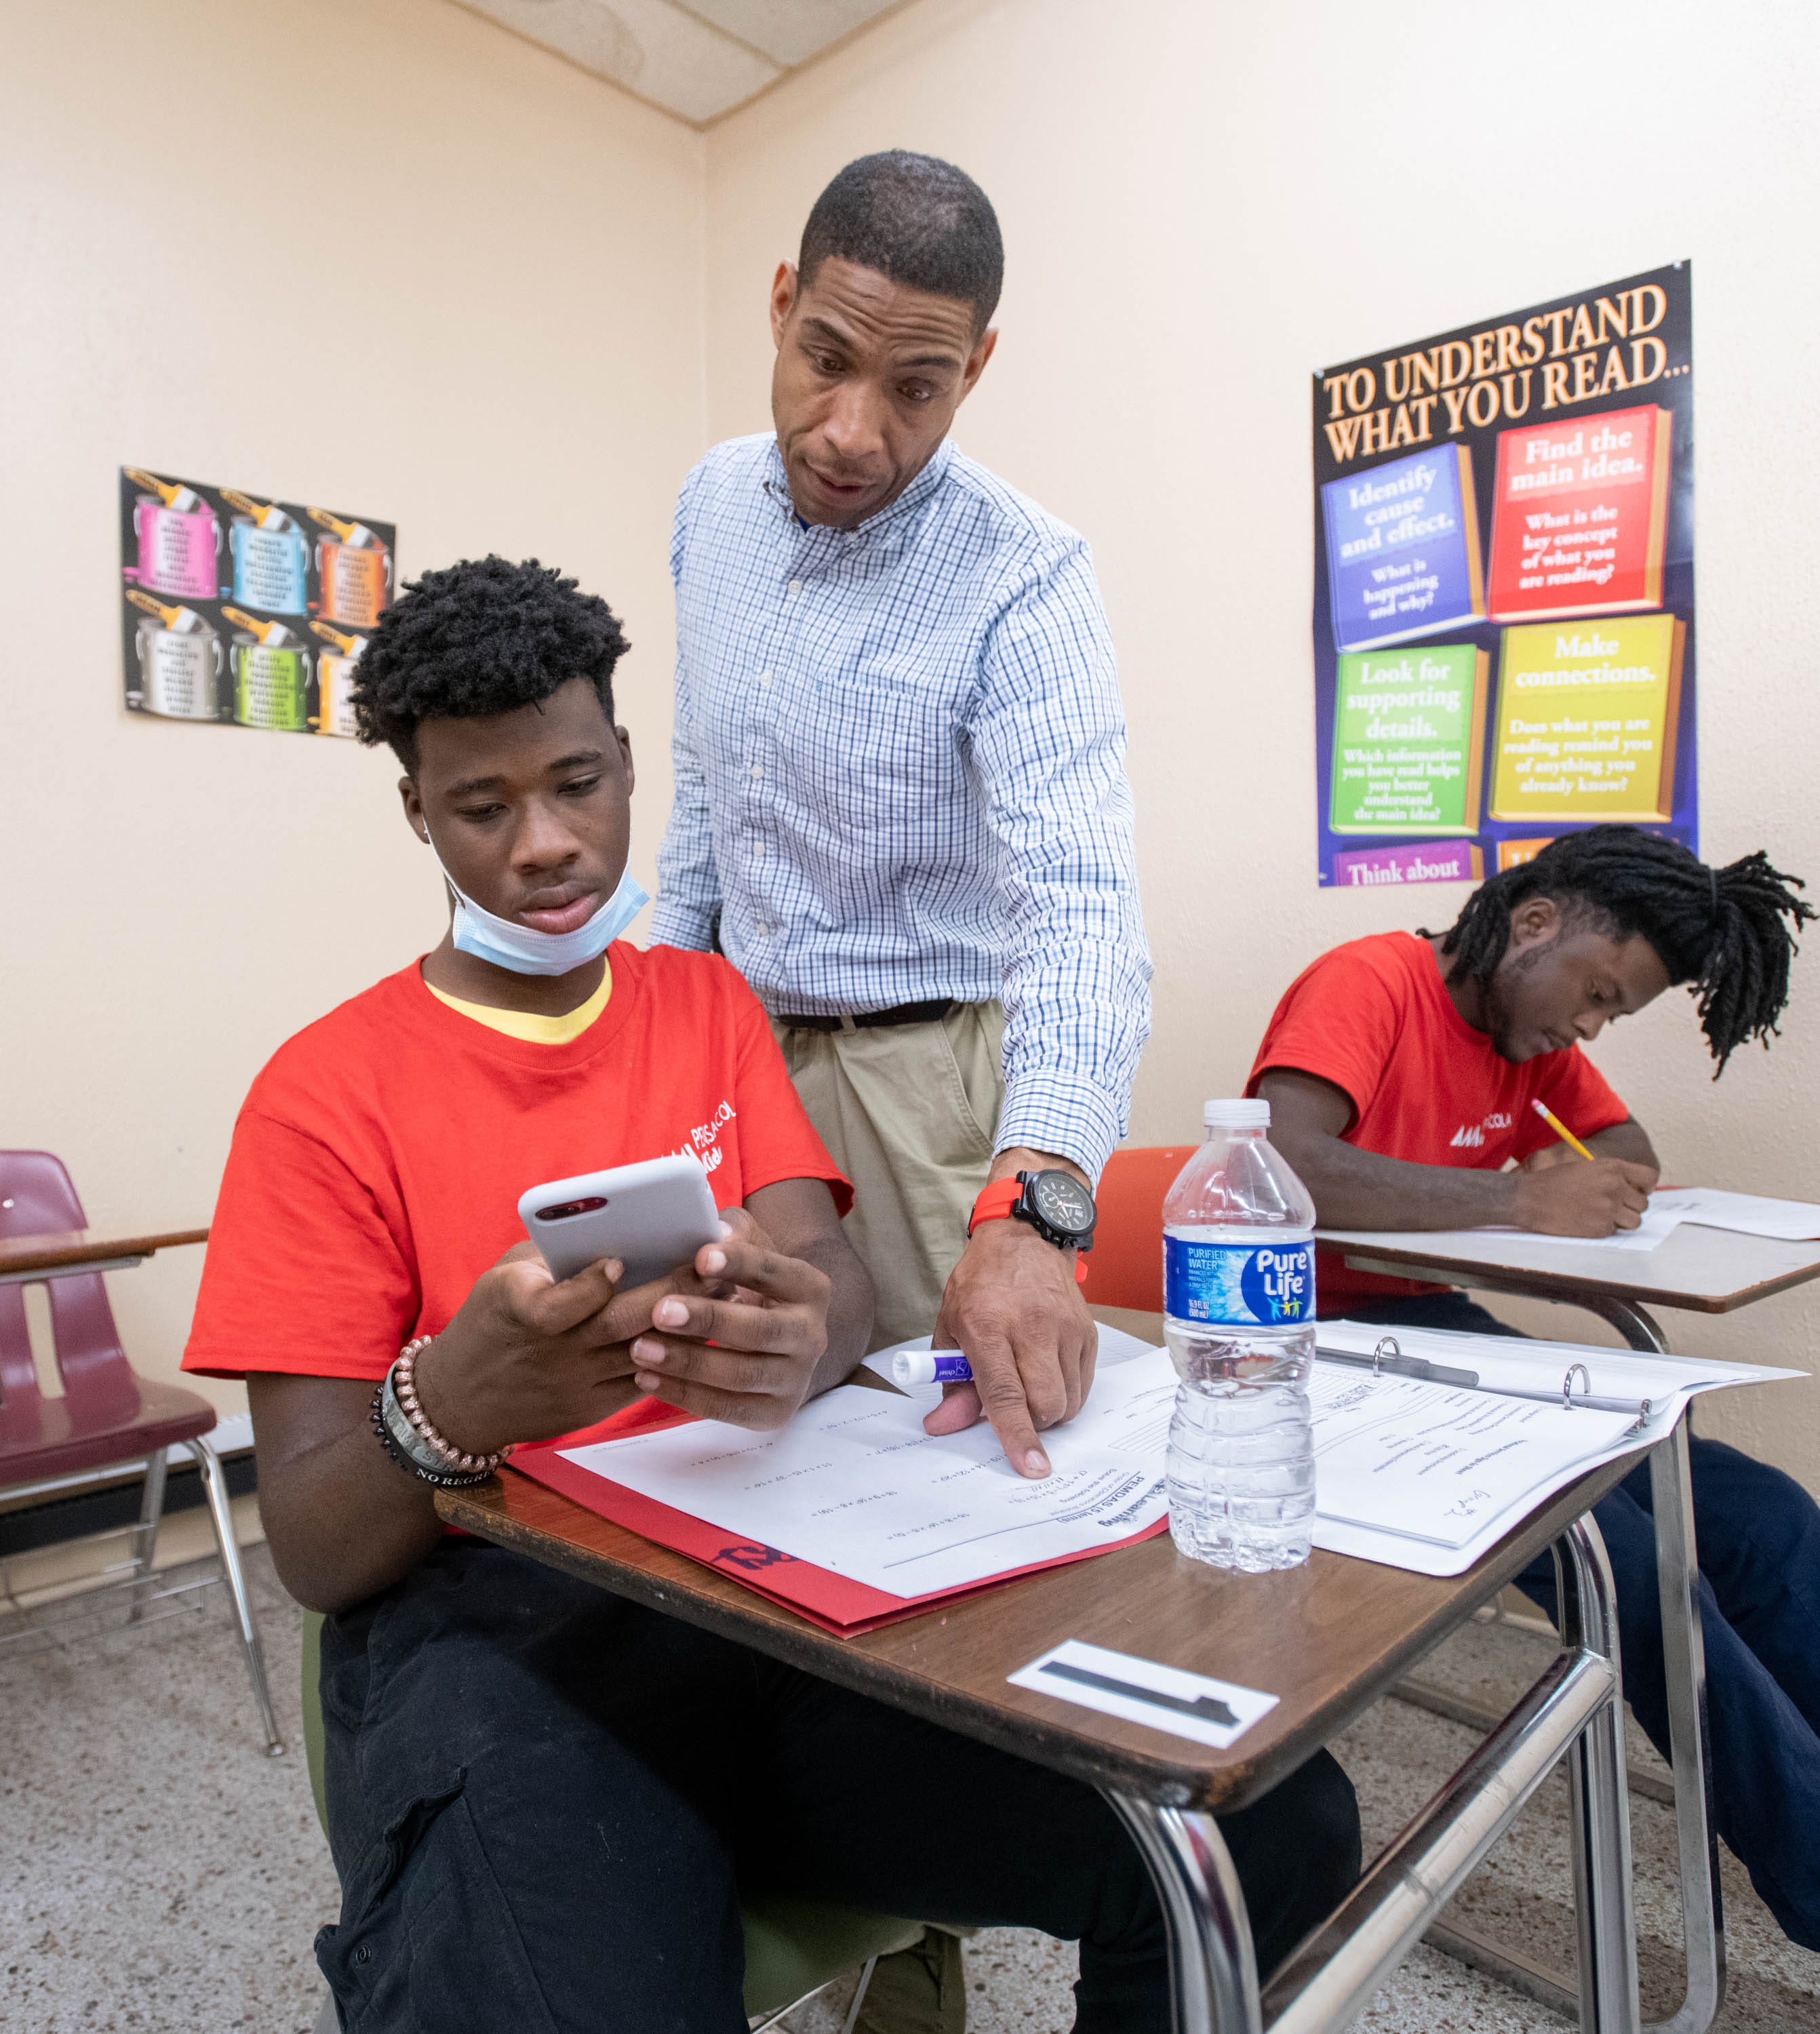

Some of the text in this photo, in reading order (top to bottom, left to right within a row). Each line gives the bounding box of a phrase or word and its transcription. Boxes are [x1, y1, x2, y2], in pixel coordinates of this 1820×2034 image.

[1323, 283, 1667, 420] TO UNDERSTAND
[1323, 336, 1690, 464] WHAT YOU READ...
[1526, 426, 1633, 464] Find the
[1511, 454, 1643, 492] main idea.
[1349, 464, 1438, 509] Identify
[1364, 496, 1424, 526] cause
[1526, 504, 1618, 531] What is the
[1341, 513, 1454, 557] and effect.
[1522, 527, 1617, 552] key concept
[1371, 559, 1427, 582] What is
[1521, 548, 1615, 570] of what you
[1363, 575, 1439, 603] happening
[1519, 575, 1543, 589] are
[1369, 599, 1396, 620] and
[1555, 633, 1619, 658] Make
[1361, 658, 1451, 685] Look for
[1516, 662, 1655, 687] connections.
[1347, 685, 1461, 715] supporting
[1366, 715, 1438, 739] details.
[1509, 717, 1650, 736] Does what you are
[1503, 736, 1652, 757] reading remind you
[1515, 757, 1635, 776] of anything you
[1520, 776, 1575, 796] already
[1348, 858, 1459, 885] Think about
[1189, 1248, 1226, 1260] PURIFIED
[1189, 1258, 1218, 1269] WATER
[1257, 1250, 1307, 1272] Pure
[1264, 1272, 1303, 1300] Life
[417, 1469, 490, 1485] NO REGR
[1057, 1476, 1145, 1523] PEMDAS (5 terms)
